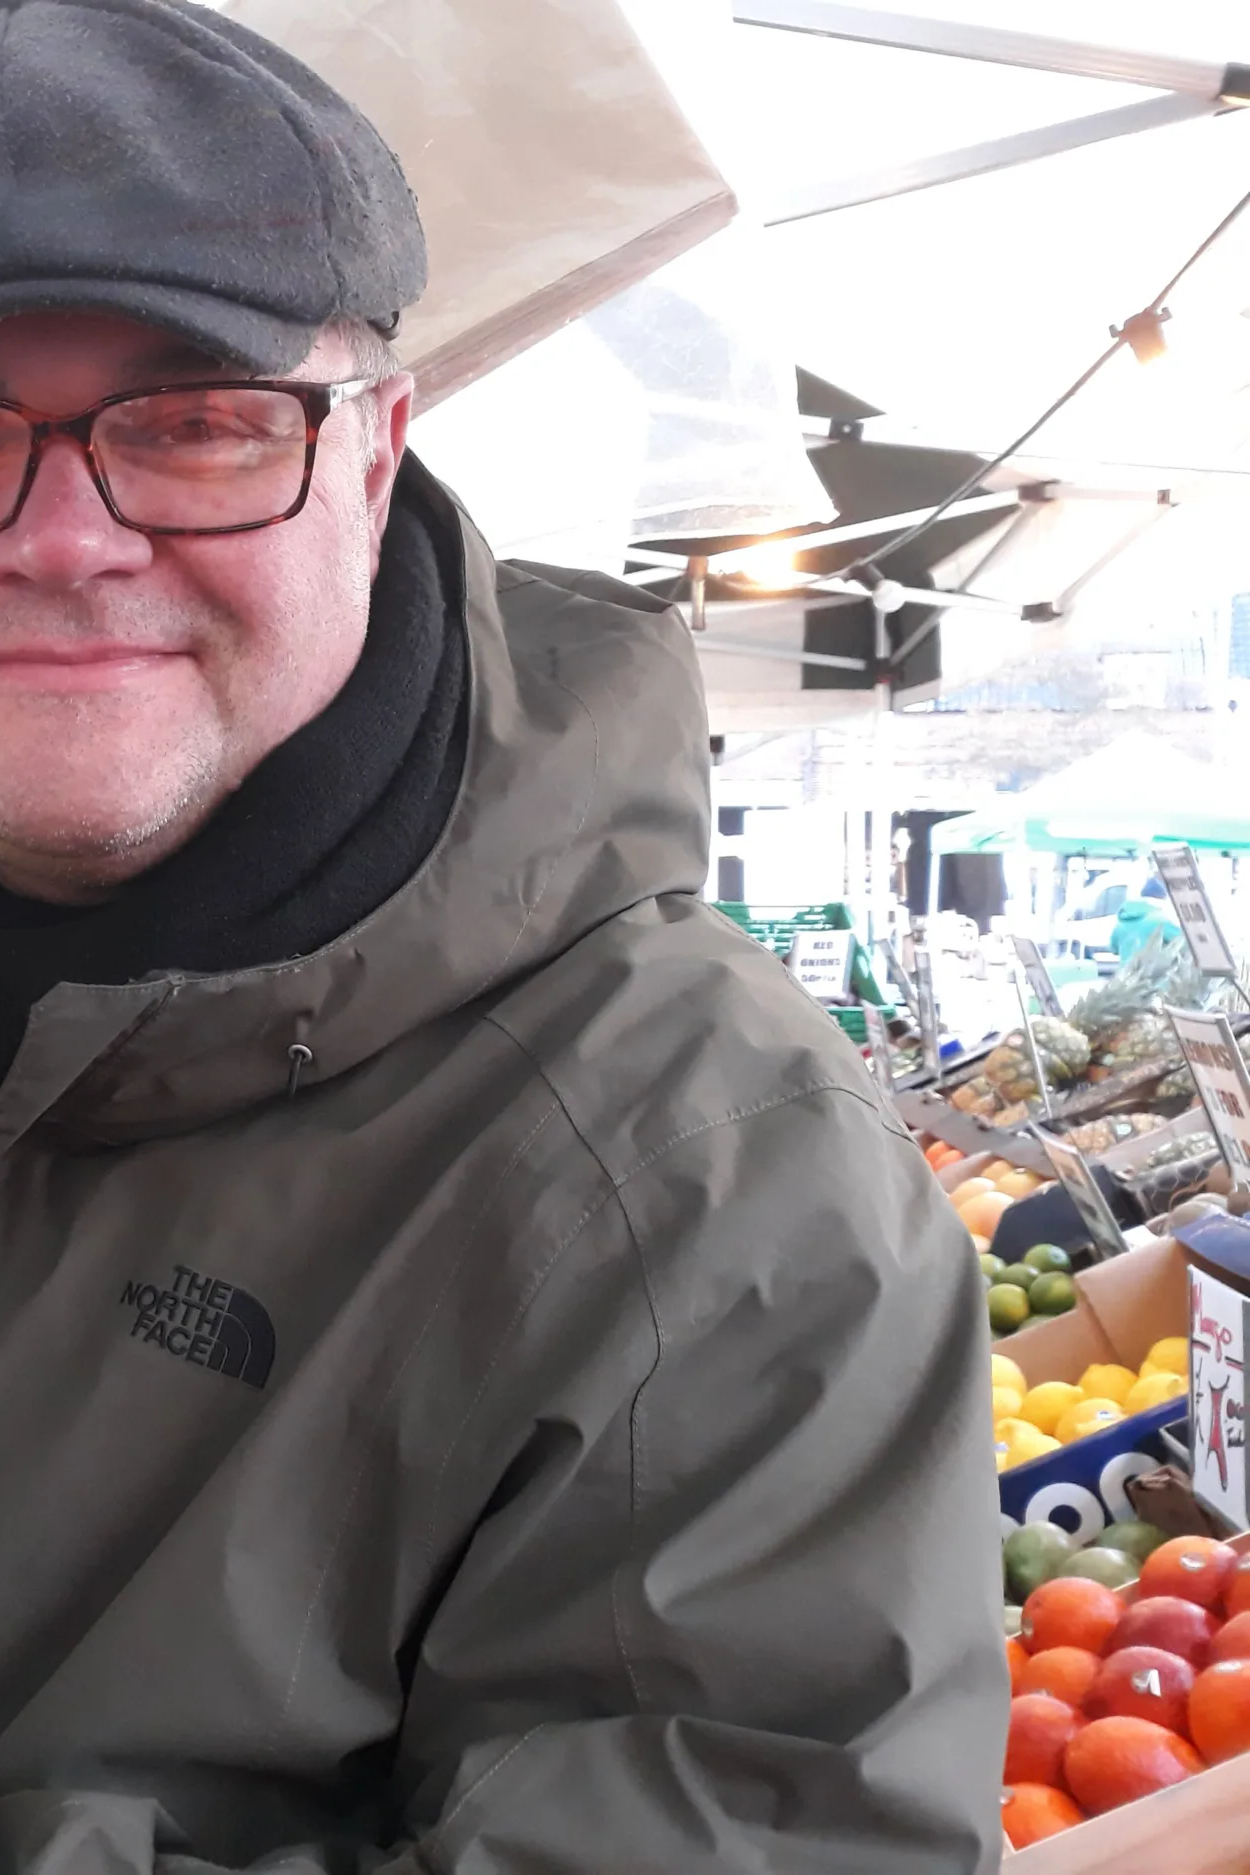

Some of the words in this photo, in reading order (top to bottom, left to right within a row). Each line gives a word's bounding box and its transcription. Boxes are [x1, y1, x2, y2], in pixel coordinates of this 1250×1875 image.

[120, 1280, 224, 1341] NORTH
[173, 1265, 233, 1312] THE
[130, 1311, 213, 1366] FACE
